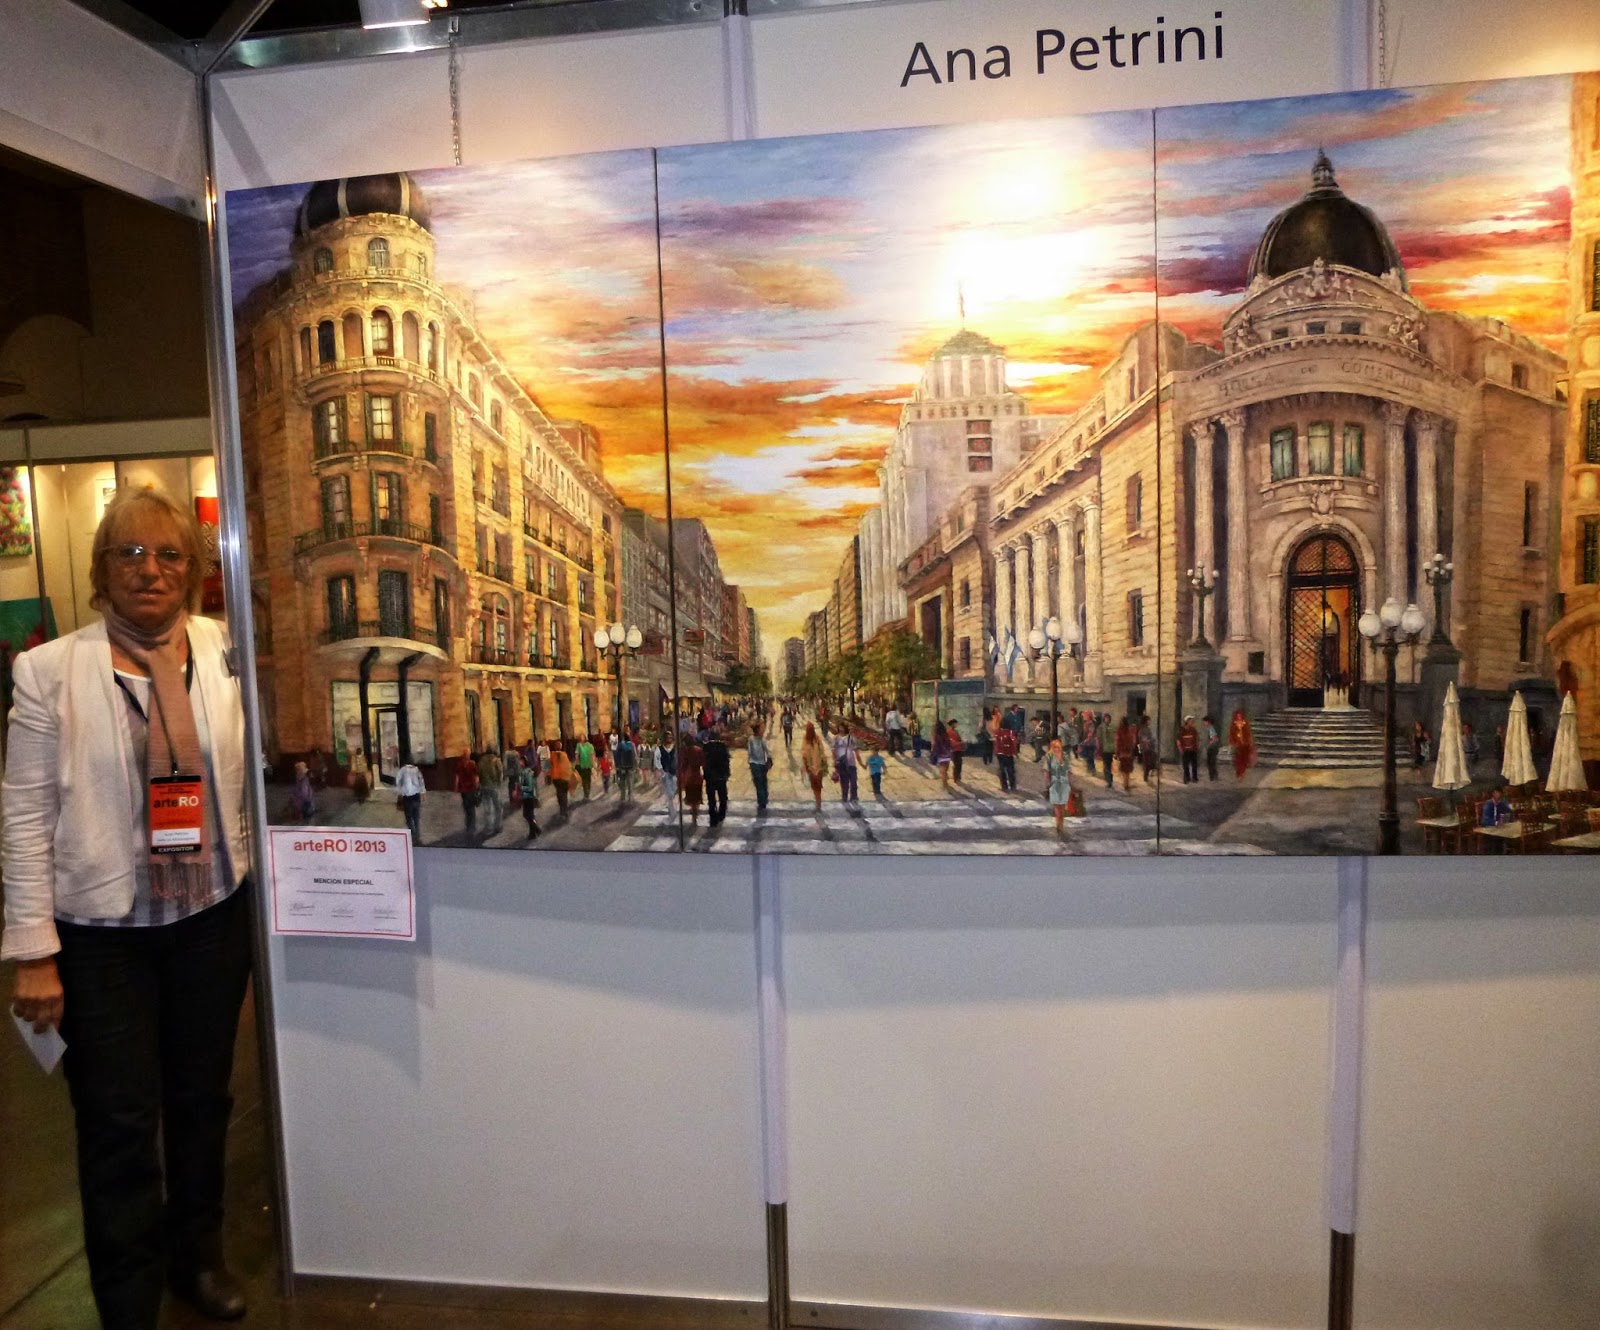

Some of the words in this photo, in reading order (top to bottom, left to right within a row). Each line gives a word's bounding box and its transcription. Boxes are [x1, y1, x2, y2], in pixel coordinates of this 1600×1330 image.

[900, 42, 1011, 87] Ana
[1036, 11, 1223, 75] Petrini
[153, 795, 199, 808] arteRO
[294, 839, 348, 853] arteRO
[354, 840, 387, 853] 2013
